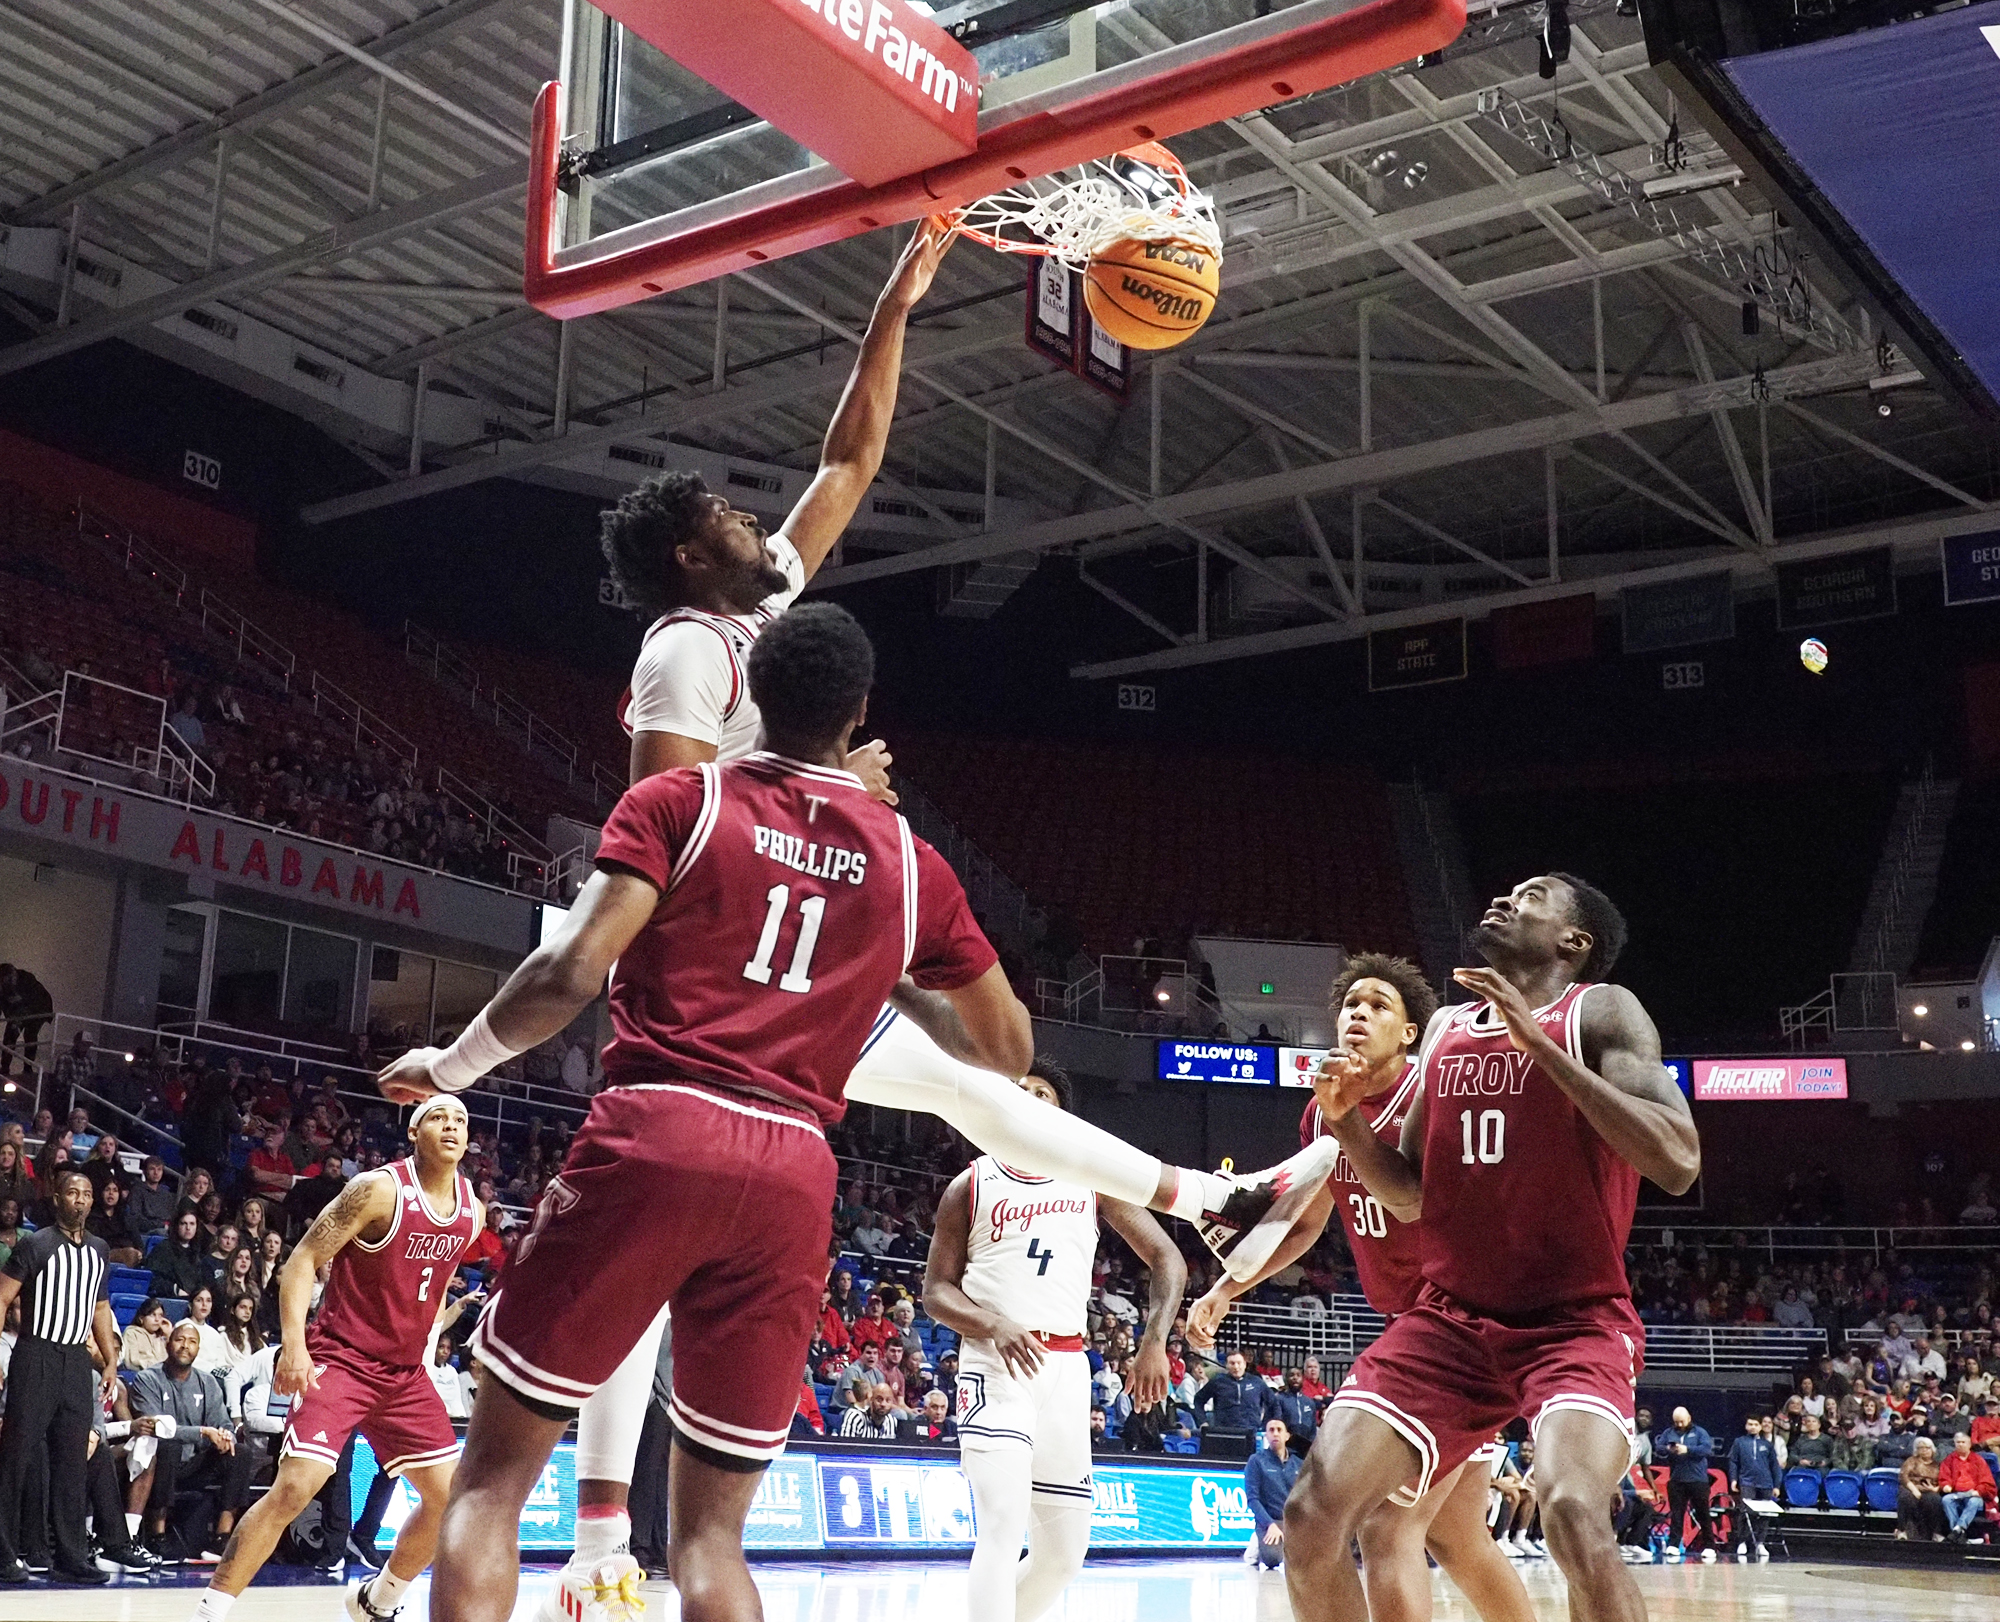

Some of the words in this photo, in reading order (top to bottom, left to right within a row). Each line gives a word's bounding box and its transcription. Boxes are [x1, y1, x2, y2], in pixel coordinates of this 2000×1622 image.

[1047, 278, 1062, 300] 32
[1122, 275, 1203, 321] Wilson
[186, 455, 219, 484] 310
[1397, 653, 1436, 671] STATE
[1664, 664, 1702, 686] 313
[1119, 687, 1154, 707] 312
[170, 820, 420, 918] ALABAMA
[753, 825, 867, 885] PHILLIPS
[742, 883, 827, 994] 11
[1175, 1044, 1233, 1060] FOLLOW
[1234, 1048, 1258, 1062] US:
[1438, 1052, 1534, 1097] TROY
[1701, 1065, 1786, 1089] JAGUAR
[1796, 1082, 1842, 1093] TODAY!
[1801, 1067, 1833, 1081] JOIN
[1701, 1087, 1750, 1095] ATHLETIC
[1755, 1086, 1783, 1094] FUND
[1460, 1109, 1506, 1164] 10
[990, 1198, 1086, 1242] Jaguars
[1349, 1194, 1388, 1239] 30
[405, 1232, 465, 1261] TROY
[1026, 1238, 1054, 1276] 4
[417, 1267, 434, 1302] 2
[839, 1475, 863, 1529] 3
